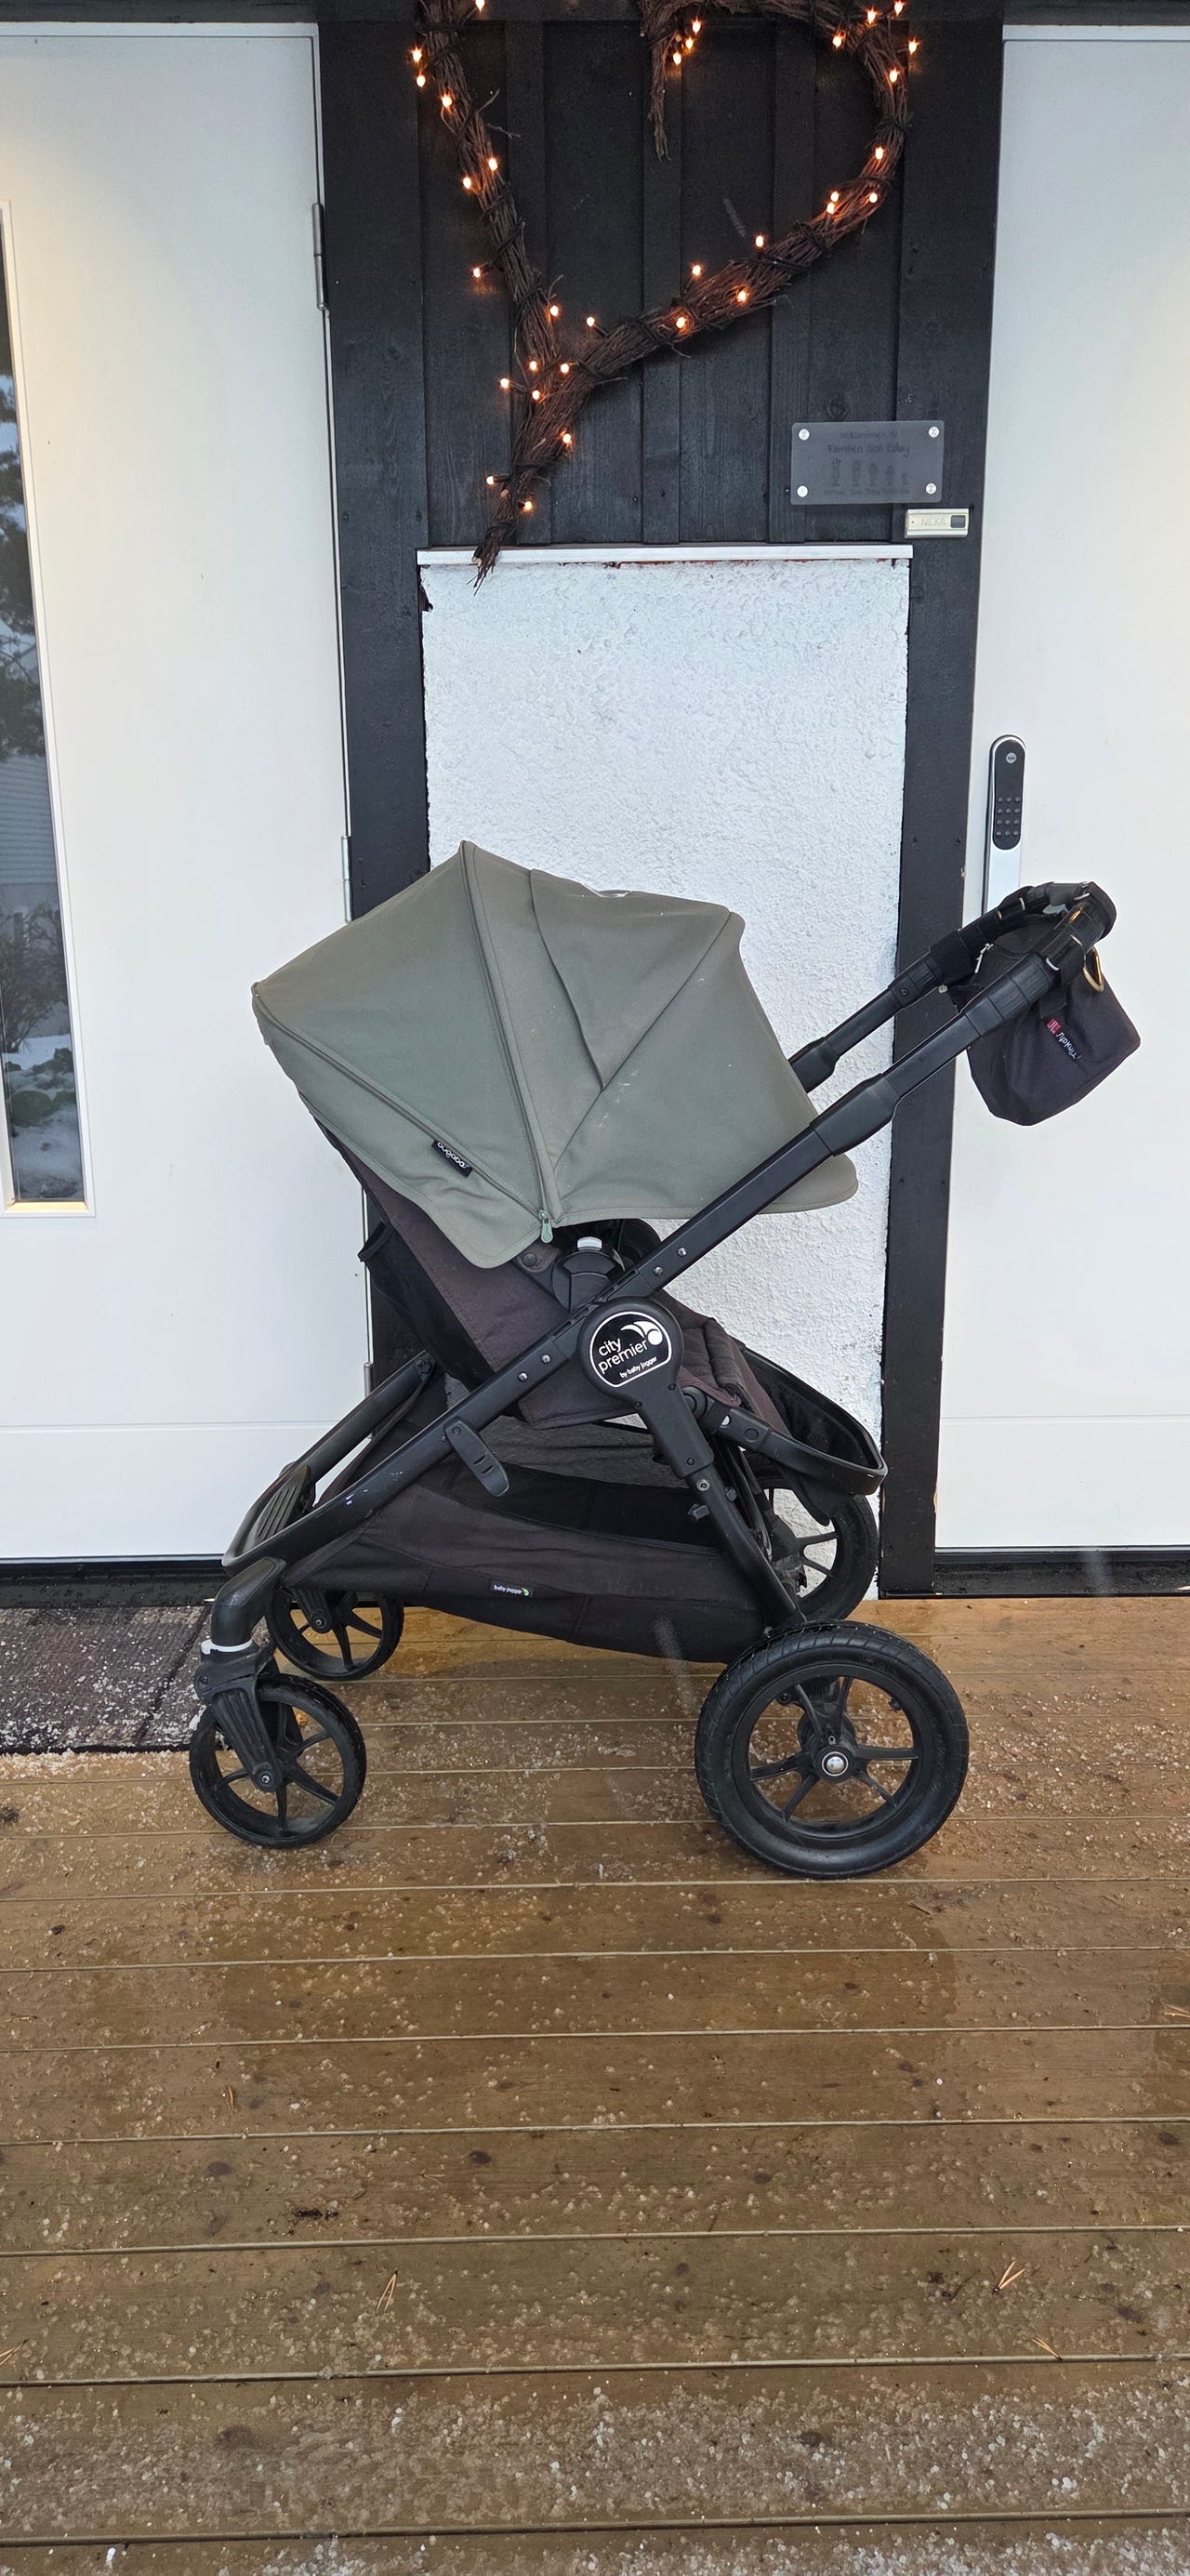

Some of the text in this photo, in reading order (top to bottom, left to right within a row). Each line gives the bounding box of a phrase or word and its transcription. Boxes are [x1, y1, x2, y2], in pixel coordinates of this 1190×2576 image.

[920, 517, 946, 527] NEXA
[598, 1338, 622, 1356] city
[598, 1340, 648, 1375] premier
[627, 1364, 641, 1375] baby
[640, 1356, 657, 1369] jogger
